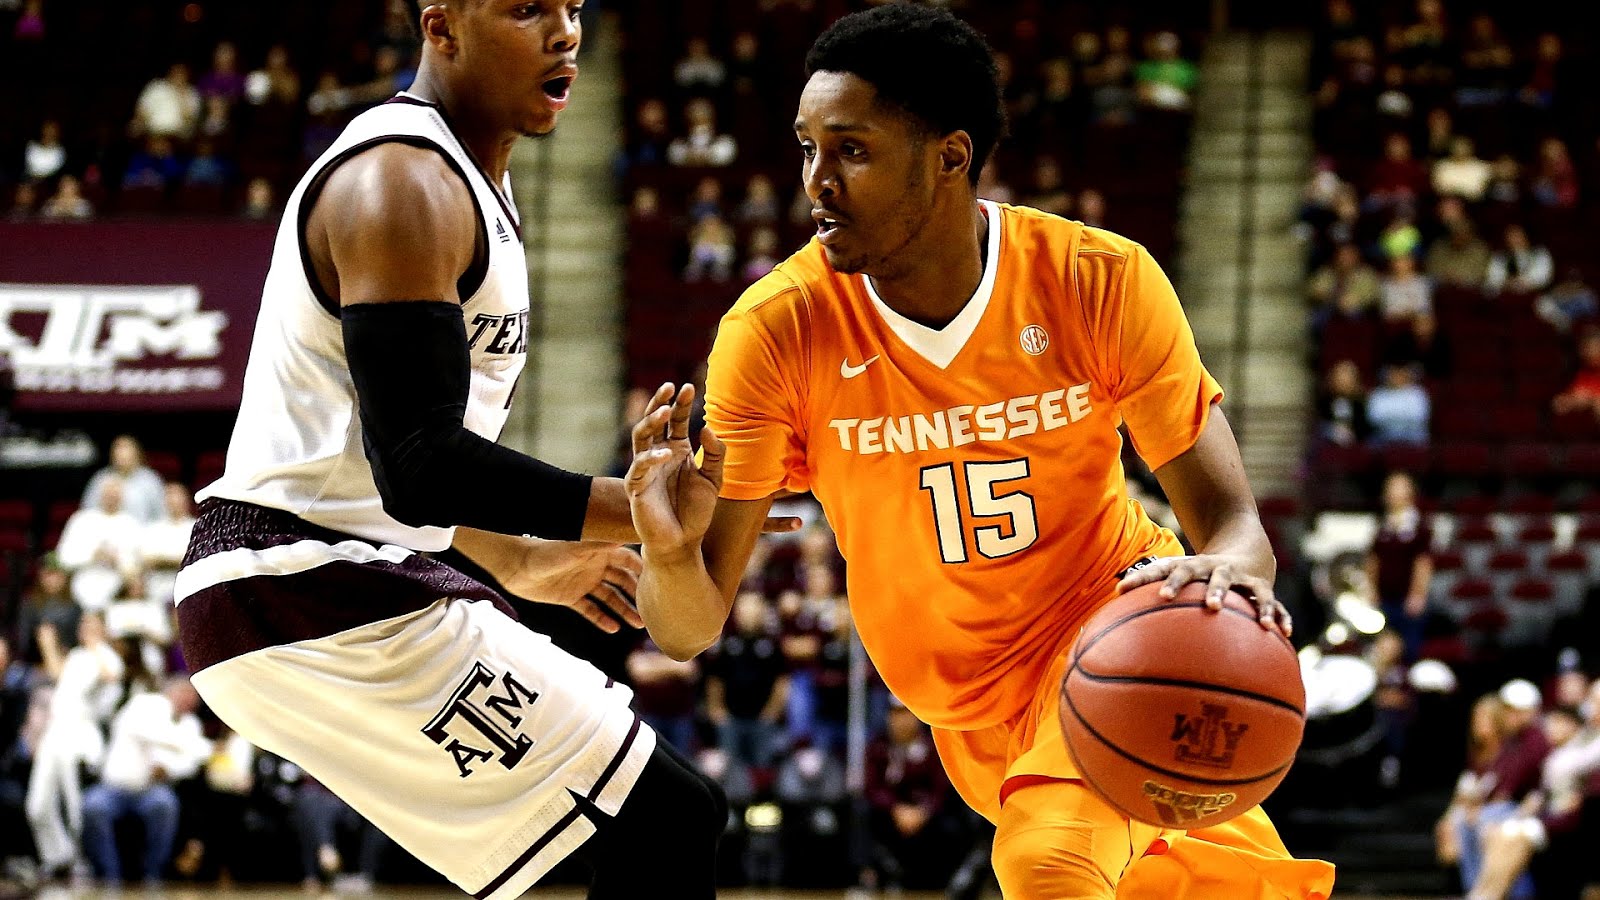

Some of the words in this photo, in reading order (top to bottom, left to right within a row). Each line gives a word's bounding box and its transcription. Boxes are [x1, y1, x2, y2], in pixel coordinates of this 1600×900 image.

[1021, 326, 1048, 353] SEC
[828, 381, 1093, 455] TENNESSEE
[919, 457, 1039, 564] 15
[1143, 779, 1237, 806] adidas
